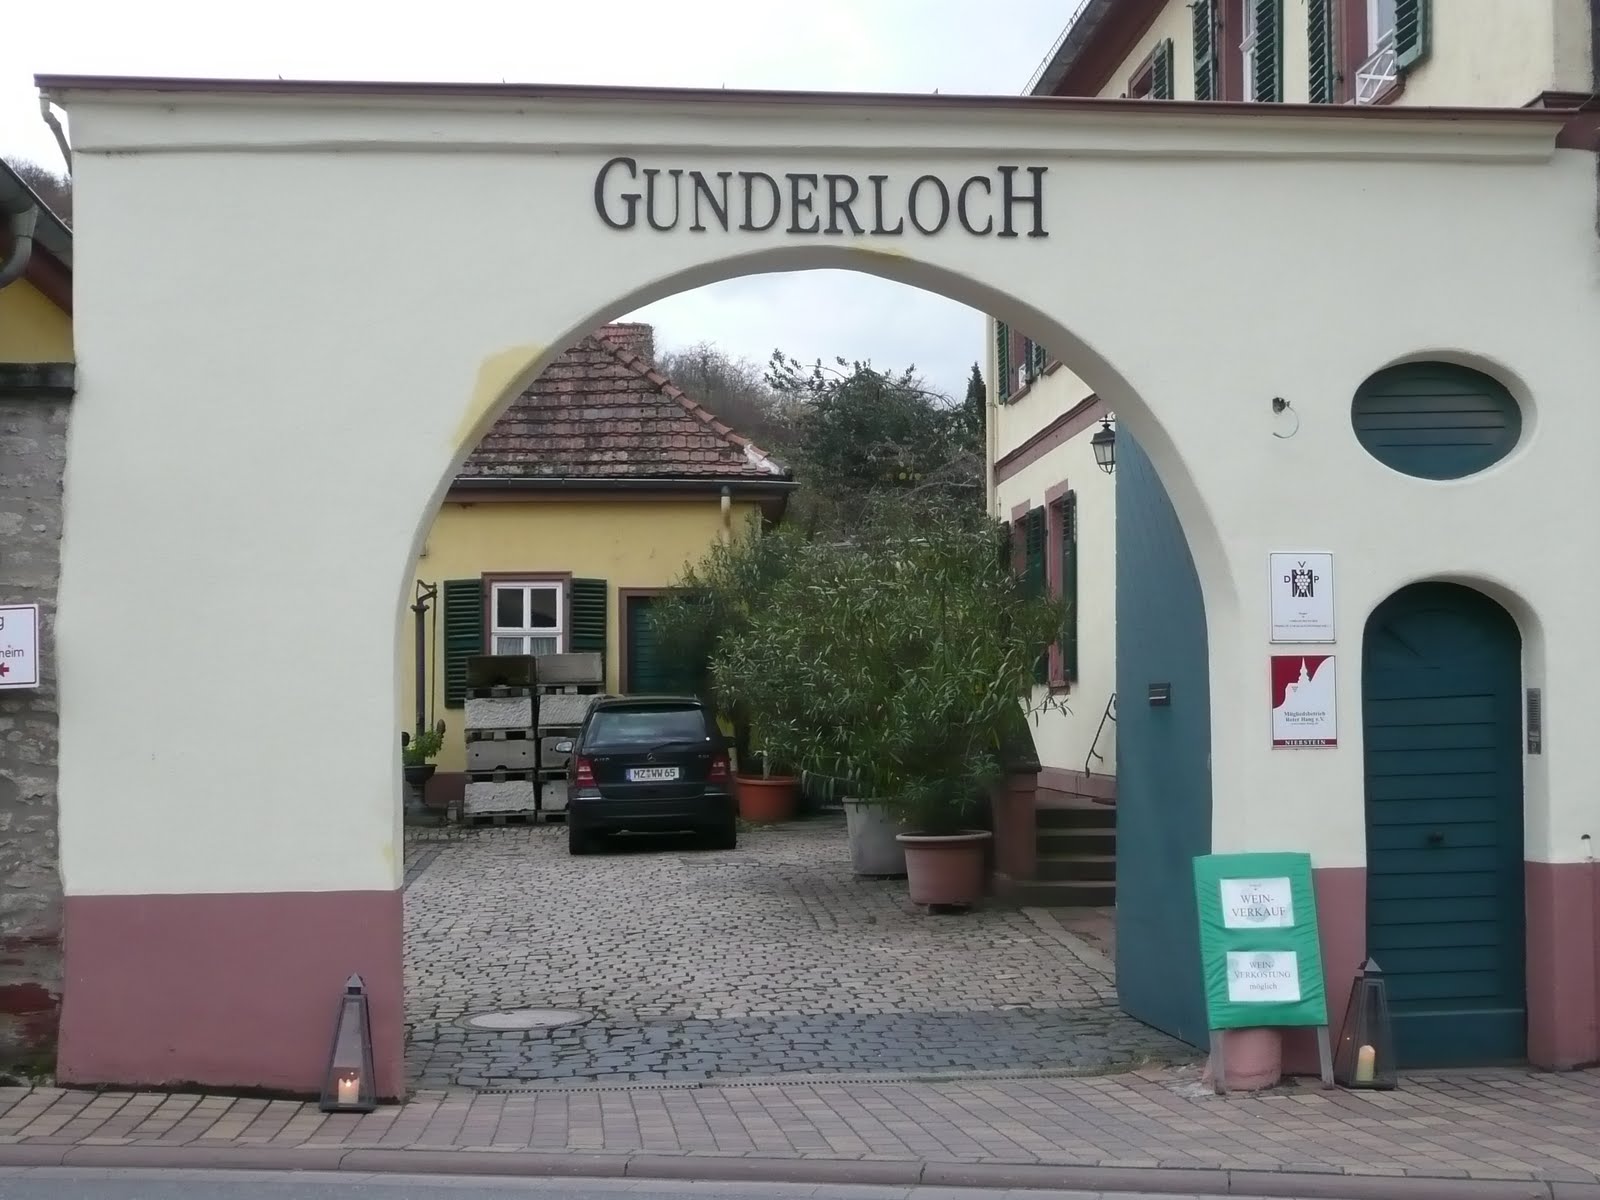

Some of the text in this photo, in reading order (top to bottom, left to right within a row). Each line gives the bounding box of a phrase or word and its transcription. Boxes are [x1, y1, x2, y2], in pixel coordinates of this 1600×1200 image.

[594, 156, 1050, 238] GUNDERLOCH
[1297, 560, 1306, 569] V
[1283, 575, 1320, 583] D P
[664, 768, 676, 777] 65
[1240, 894, 1275, 904] WEIN-
[1232, 906, 1286, 917] VERKAUF
[1249, 961, 1274, 969] WEIN-
[1234, 970, 1291, 978] VERKOSTUNG
[1249, 982, 1278, 991] möglich
